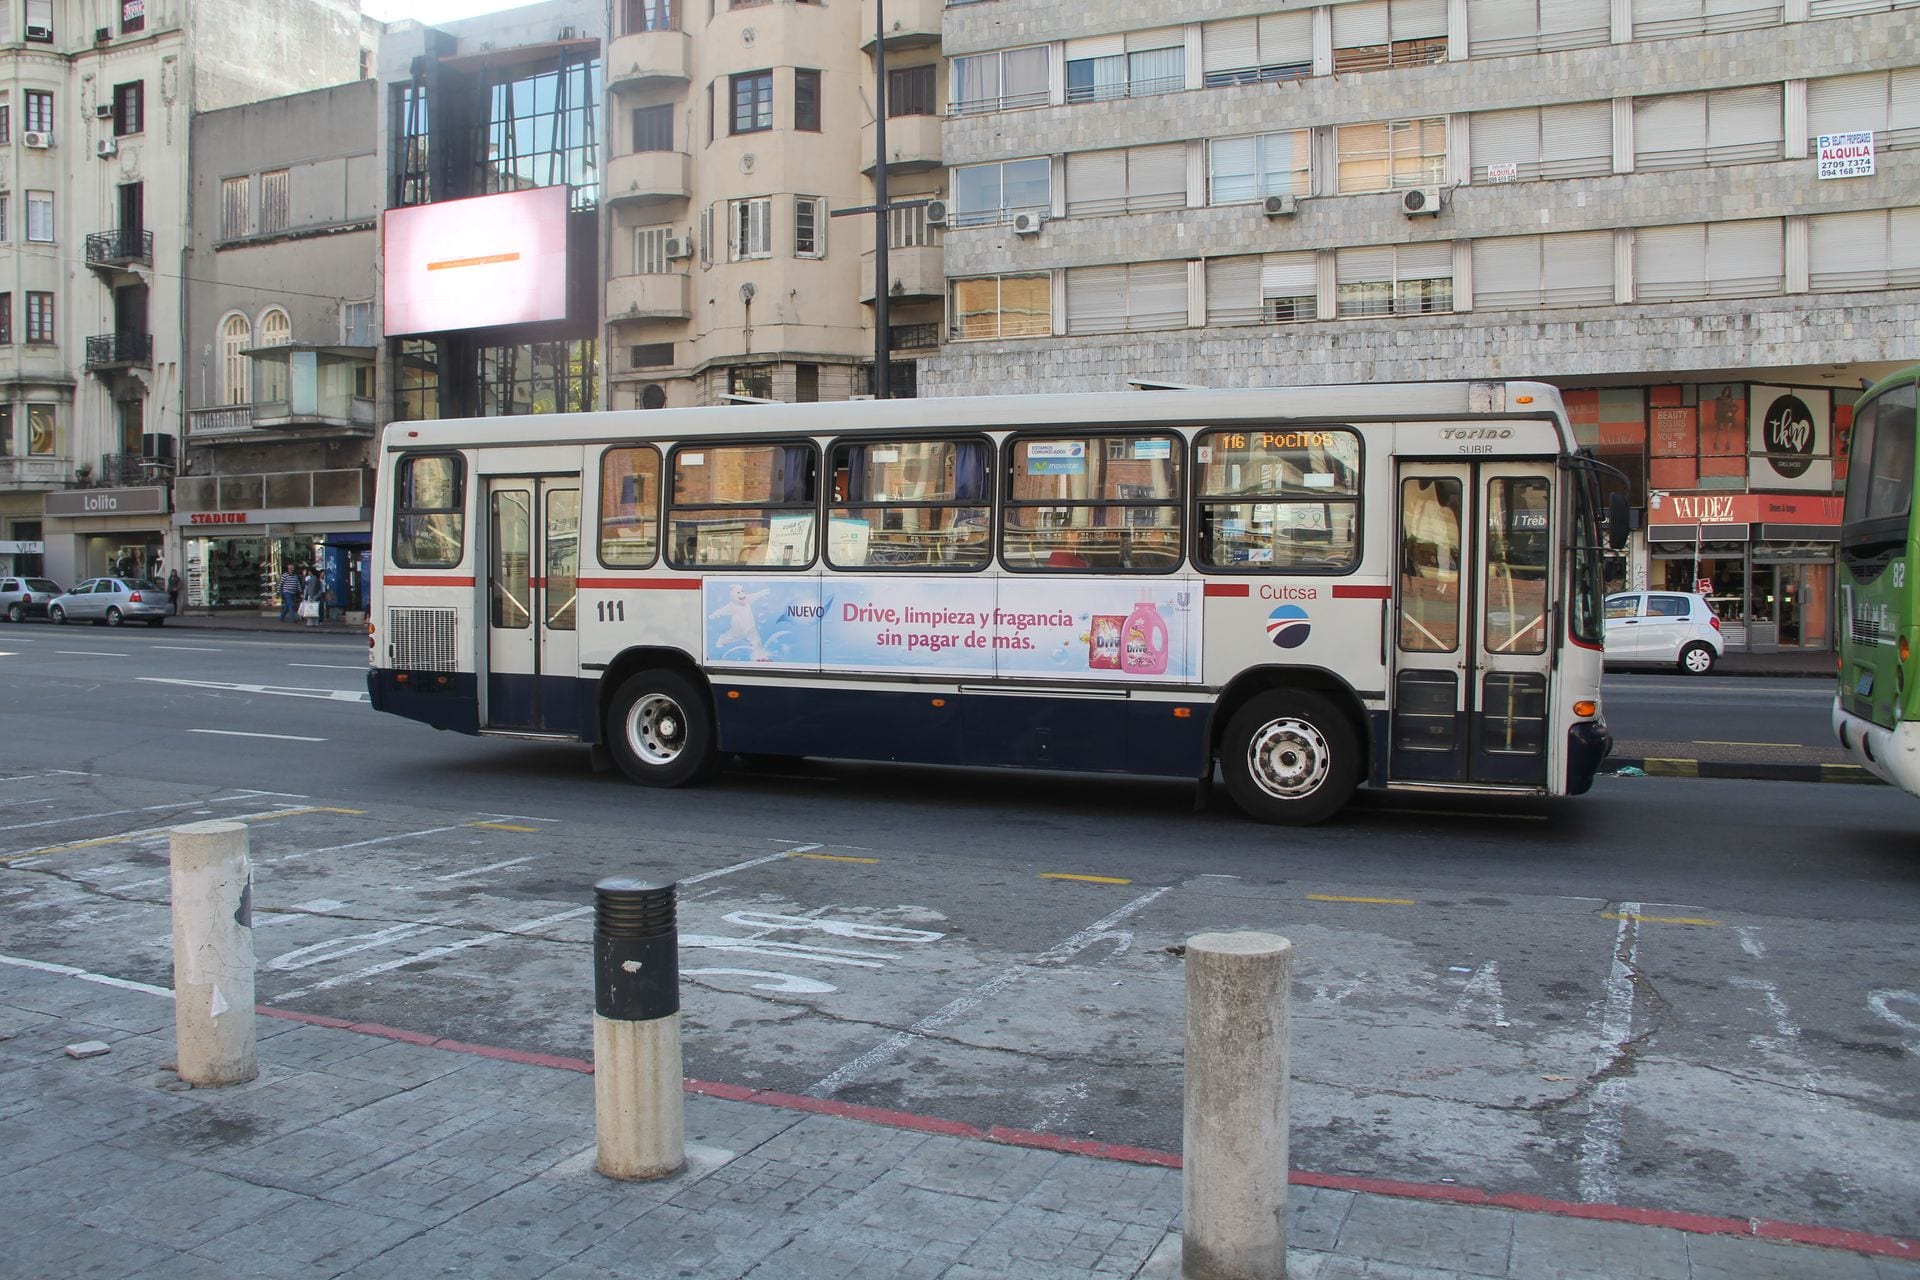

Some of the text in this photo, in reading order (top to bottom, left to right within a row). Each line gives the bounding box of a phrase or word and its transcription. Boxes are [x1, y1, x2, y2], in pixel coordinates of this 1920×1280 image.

[1822, 146, 1871, 160] ALQUILA
[1822, 159, 1871, 169] 2709 7374
[1822, 169, 1837, 177] 094
[1657, 410, 1688, 420] BEAUTY
[1443, 428, 1512, 440] Torino
[1657, 432, 1673, 441] YOU
[1223, 434, 1333, 449] 116 POCITOS
[1458, 445, 1493, 454] SUBIR
[1048, 462, 1079, 470] movistar
[84, 494, 117, 510] Lolita
[1673, 496, 1734, 518] VALDEZ
[191, 512, 246, 523] STADIUM
[1521, 515, 1545, 526] Tréb
[1893, 562, 1904, 588] 82
[1260, 584, 1317, 599] Cutcsa
[597, 600, 625, 622] 111
[788, 605, 825, 618] NUEVO
[842, 603, 1073, 630] Drive, limpieza y fragancia
[876, 629, 1035, 651] sin pagar de más.
[1097, 635, 1121, 648] Driv
[1127, 643, 1148, 653] Drive
